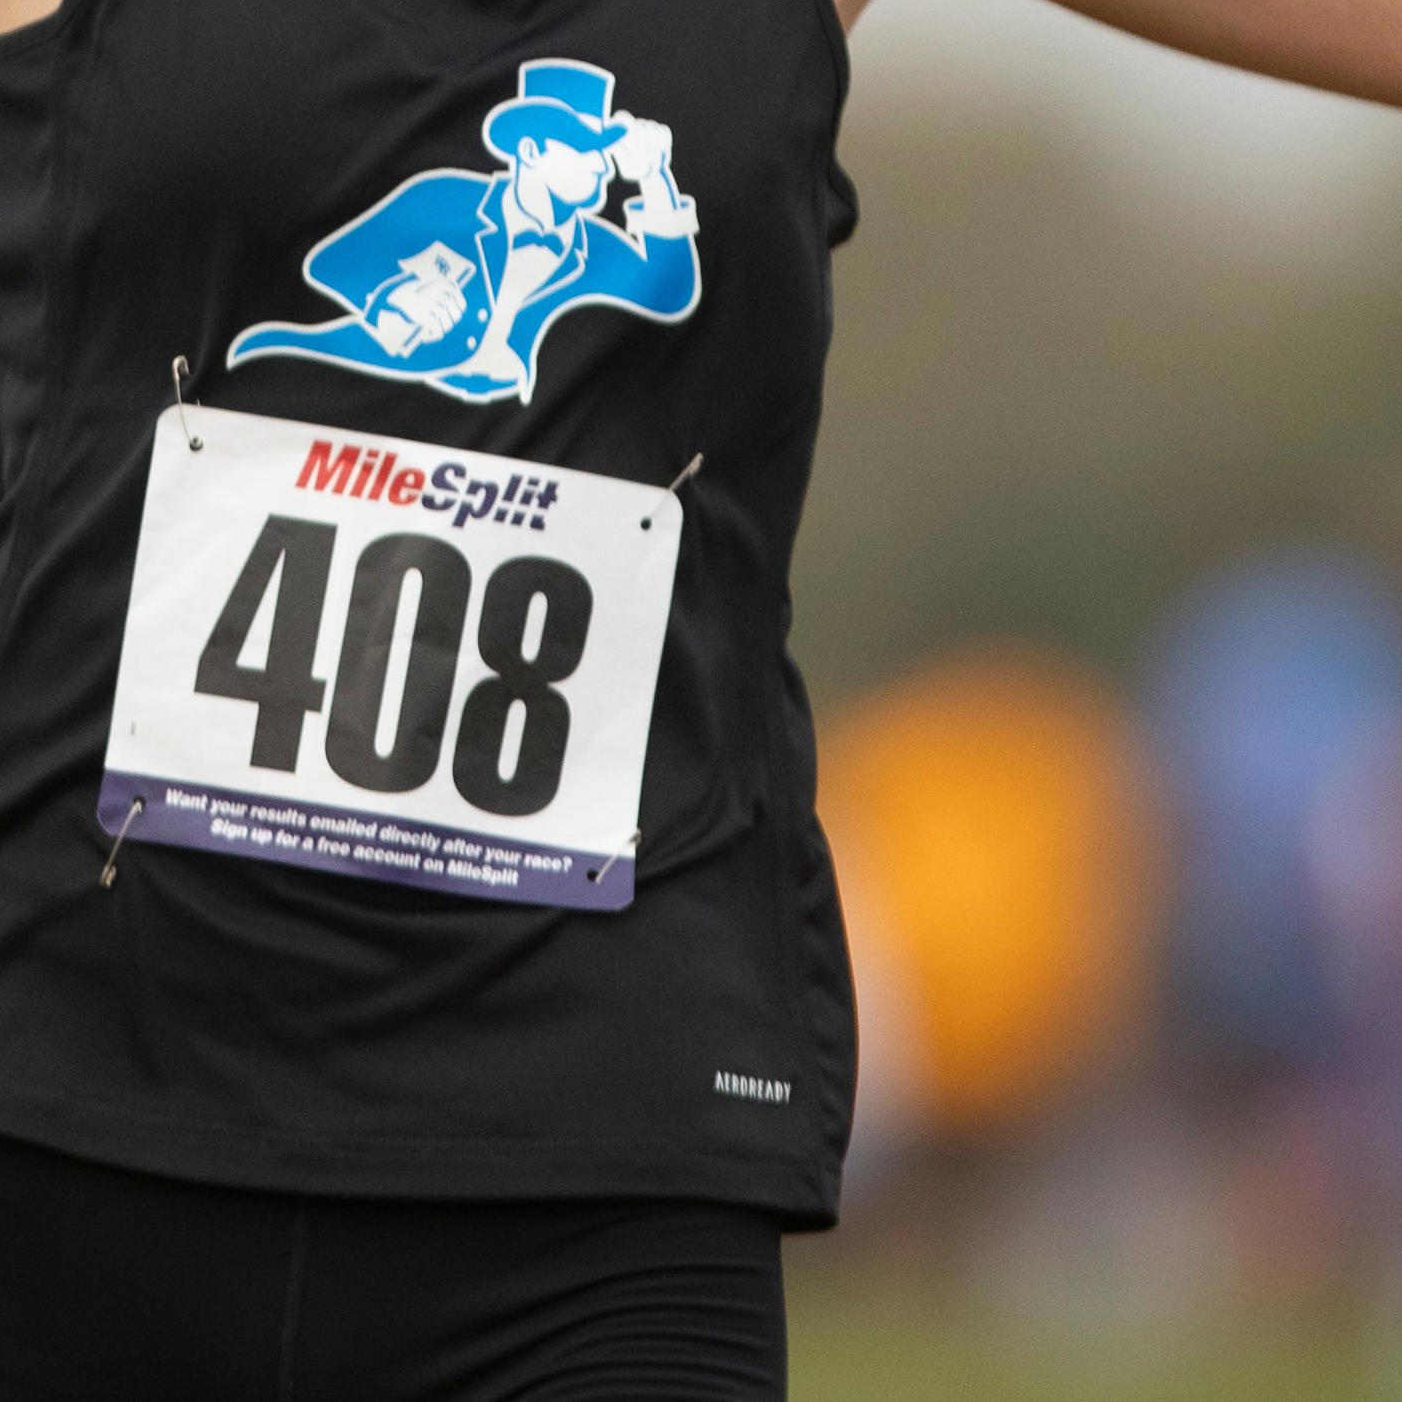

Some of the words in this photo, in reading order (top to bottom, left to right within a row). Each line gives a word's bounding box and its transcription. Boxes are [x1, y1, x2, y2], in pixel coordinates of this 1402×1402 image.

[295, 439, 559, 531] MileSplit
[194, 512, 594, 817] 408
[165, 787, 208, 812] Want
[209, 797, 248, 817] your
[250, 804, 307, 829] results
[309, 814, 378, 839] emailed
[379, 824, 441, 854] directly
[442, 837, 483, 859] after
[484, 845, 522, 866] your
[523, 853, 573, 873] race?
[210, 817, 248, 841] Sign
[250, 827, 274, 845] up
[275, 829, 301, 848] for
[302, 835, 315, 851] a
[317, 835, 351, 856] free
[352, 844, 421, 869] account
[423, 856, 445, 874] on
[446, 858, 519, 887] MileSplit
[714, 1069, 791, 1104] AEROREADY
